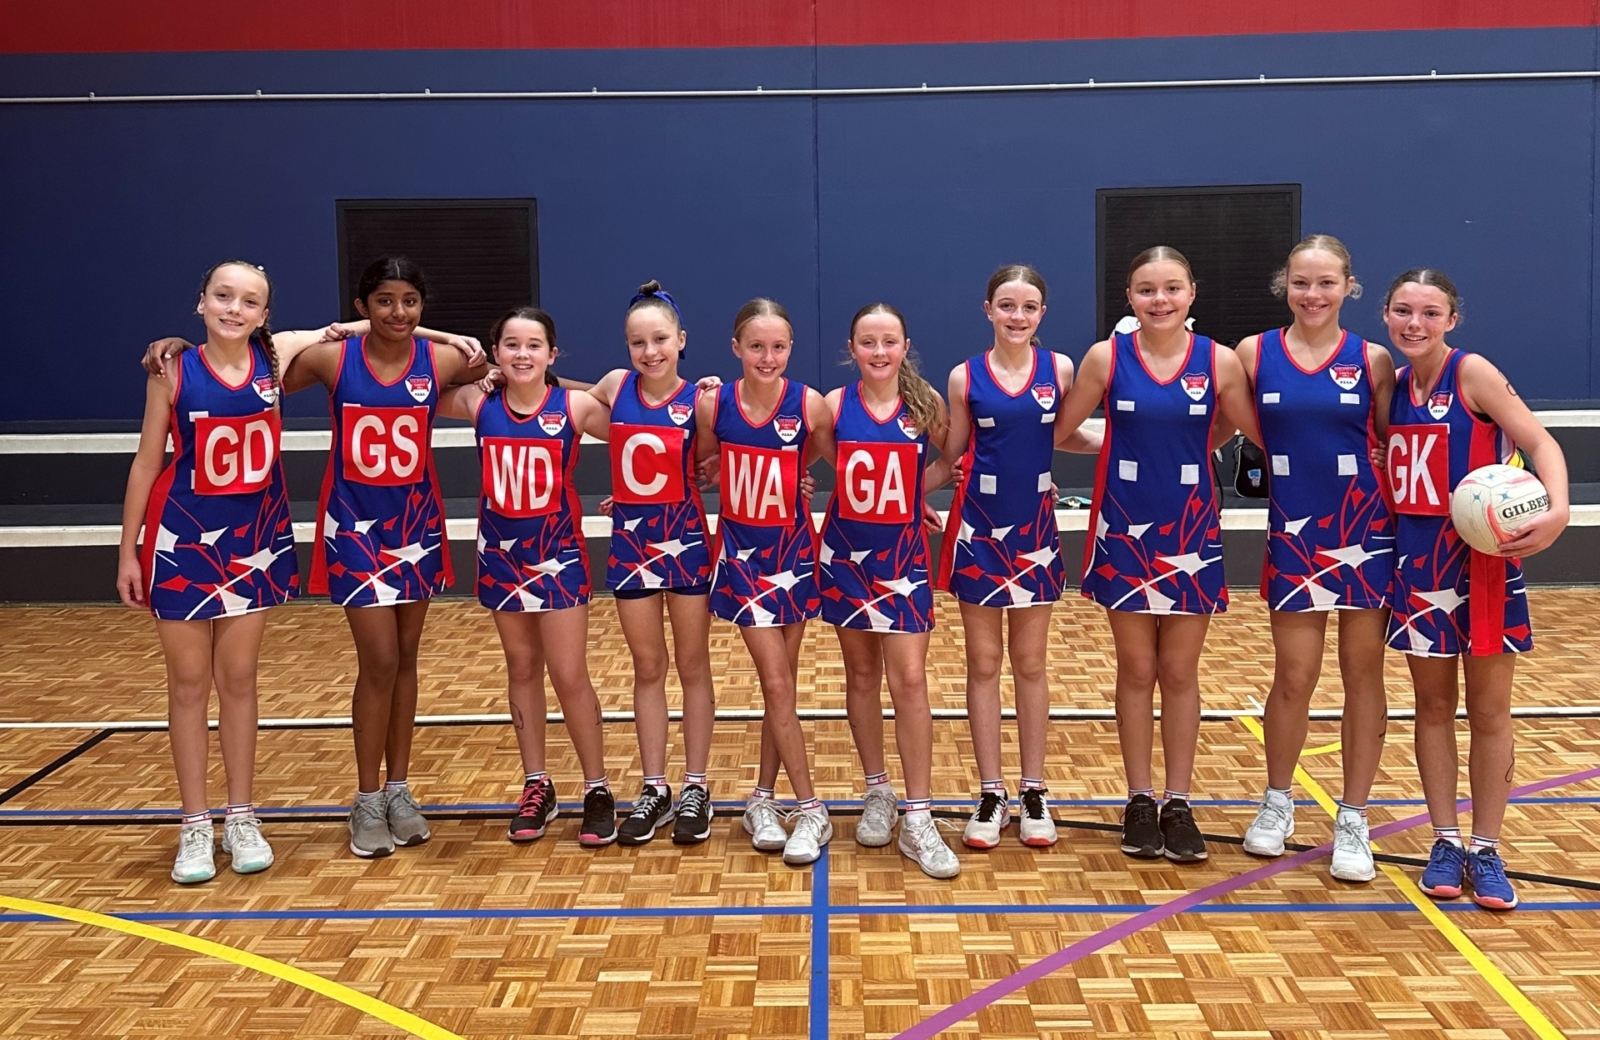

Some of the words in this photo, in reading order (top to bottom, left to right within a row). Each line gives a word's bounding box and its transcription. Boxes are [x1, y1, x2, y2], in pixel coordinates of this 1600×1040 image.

[204, 419, 274, 487] GD
[351, 414, 419, 478] GS
[489, 444, 554, 511] WD
[621, 432, 668, 496] C
[1387, 433, 1441, 506] GK
[728, 450, 787, 520] WA
[845, 449, 908, 515] GA
